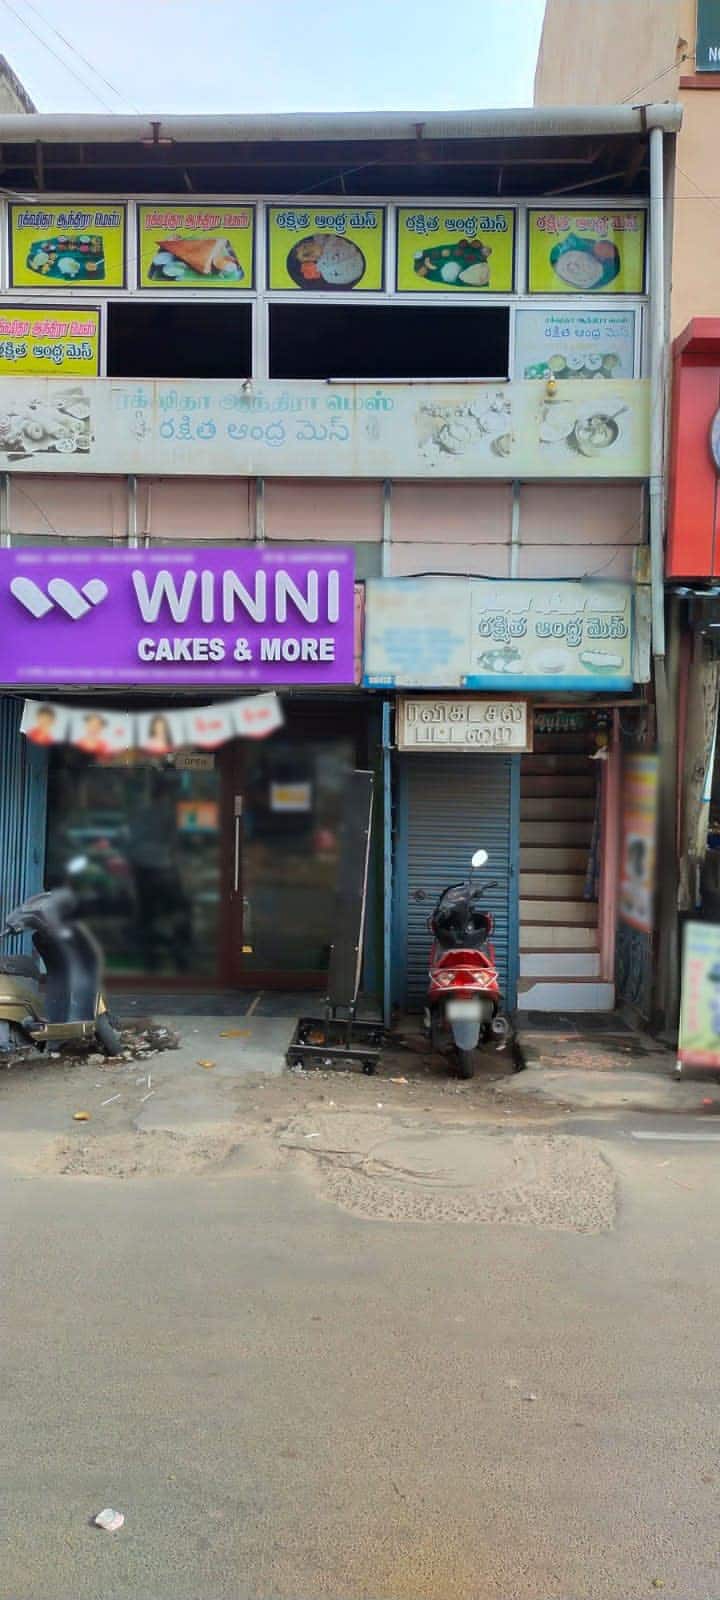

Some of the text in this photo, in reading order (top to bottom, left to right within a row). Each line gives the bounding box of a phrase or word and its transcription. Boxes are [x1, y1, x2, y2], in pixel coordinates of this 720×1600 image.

[131, 569, 340, 624] WINNI
[137, 637, 226, 662] CAKES
[233, 637, 253, 662] &
[260, 637, 336, 662] MORE
